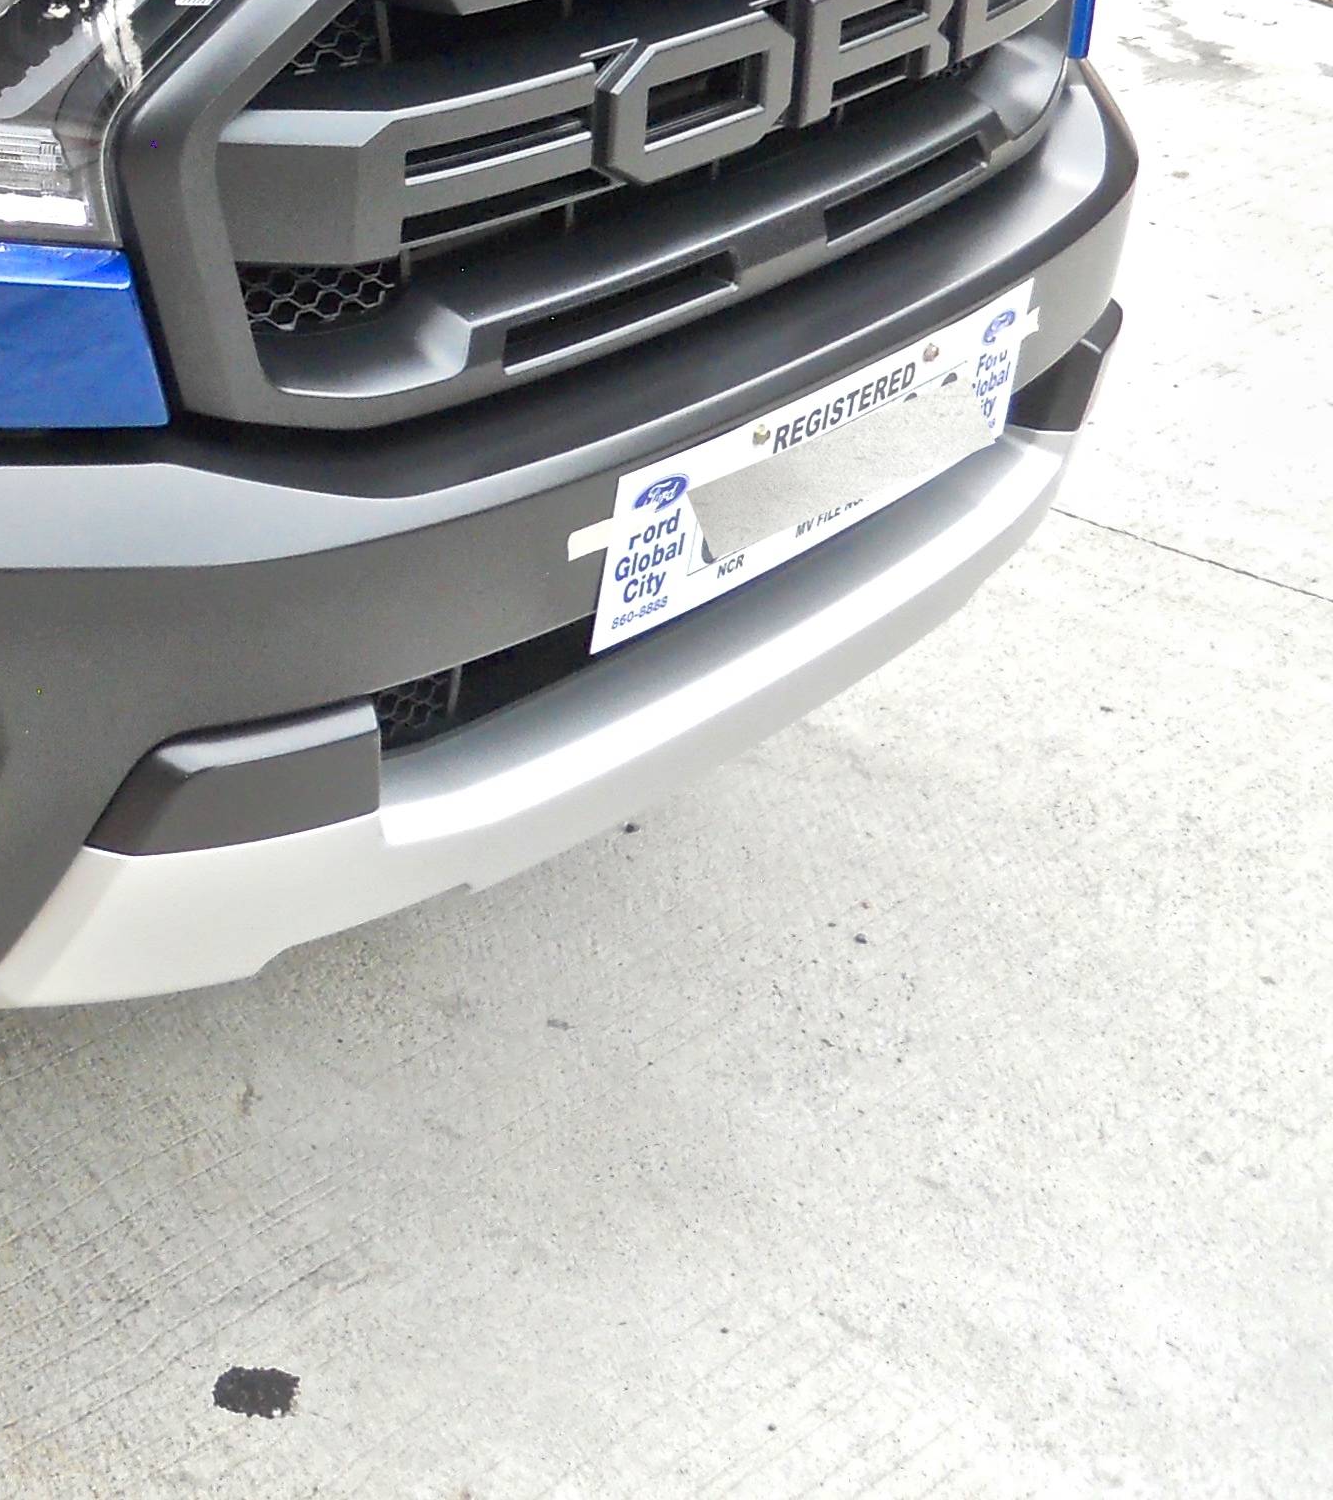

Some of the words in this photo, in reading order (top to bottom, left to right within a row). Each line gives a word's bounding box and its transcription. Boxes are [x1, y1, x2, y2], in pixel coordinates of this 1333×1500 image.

[972, 361, 1011, 398] lobal
[771, 362, 917, 455] REGISTERED
[629, 508, 682, 550] Ford
[795, 518, 814, 538] MV
[614, 532, 686, 582] Global
[716, 554, 746, 579] NCR
[623, 571, 667, 604] City
